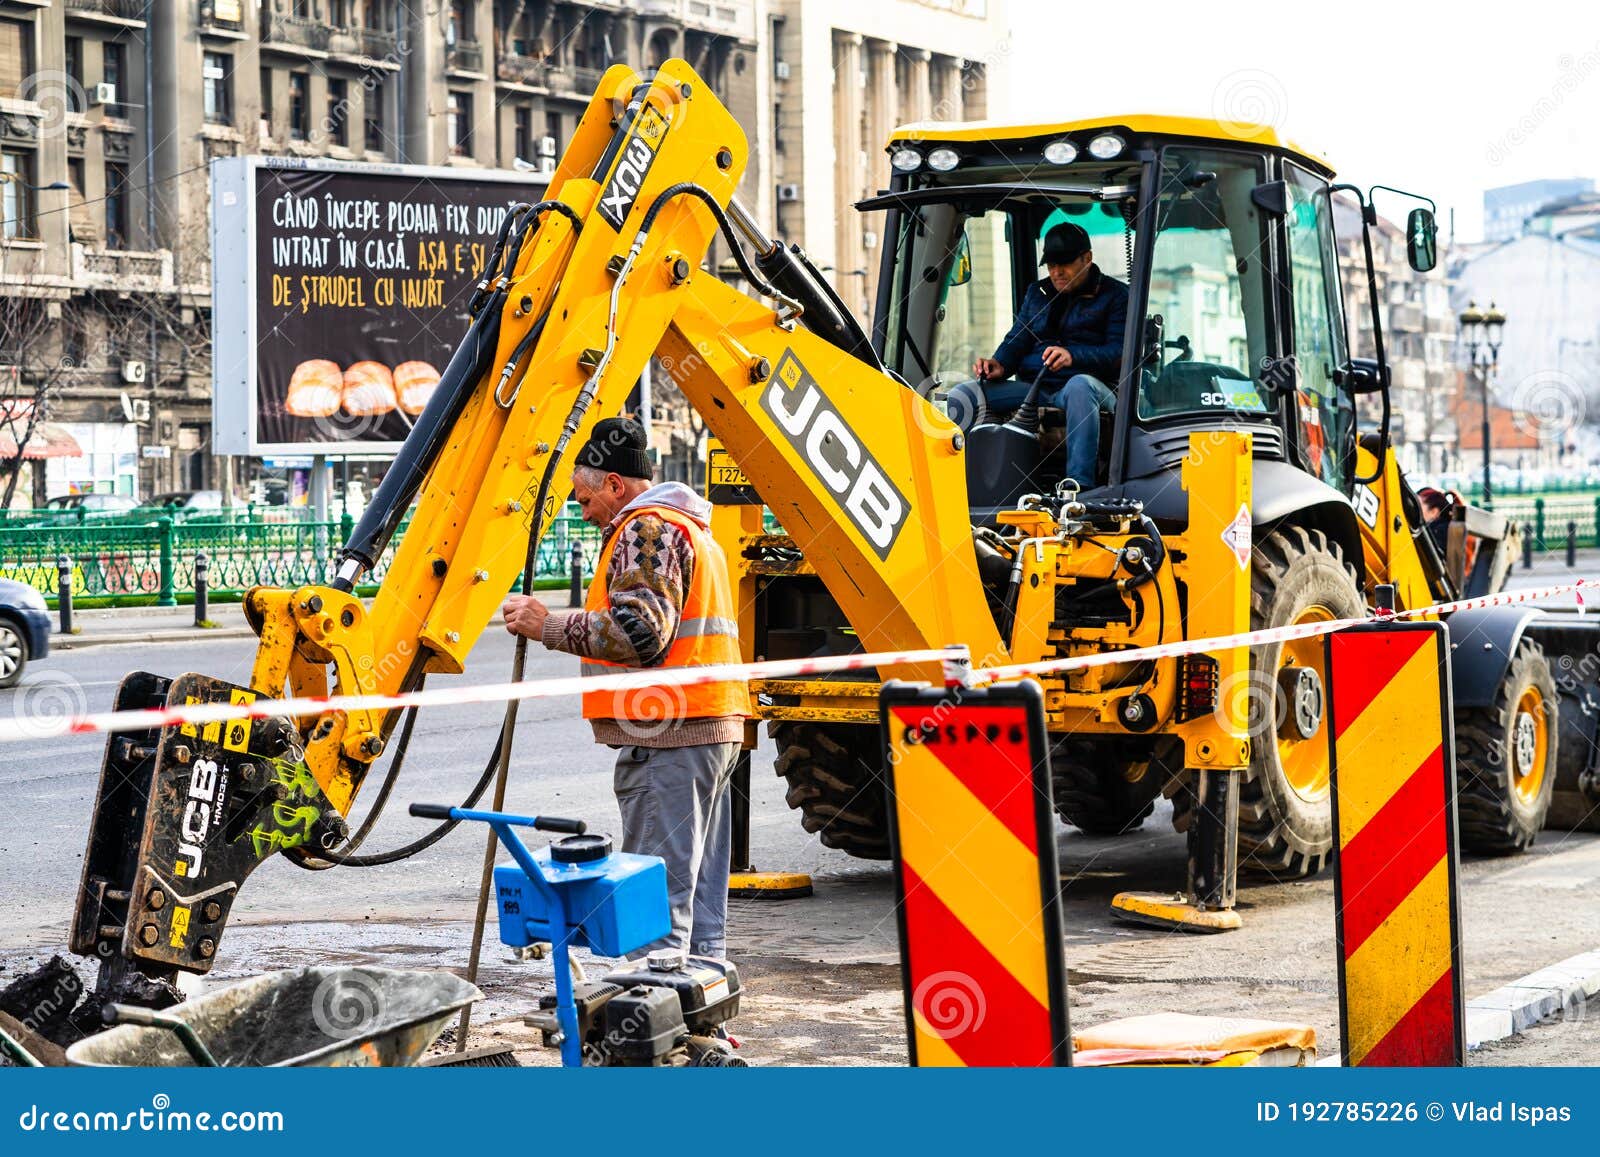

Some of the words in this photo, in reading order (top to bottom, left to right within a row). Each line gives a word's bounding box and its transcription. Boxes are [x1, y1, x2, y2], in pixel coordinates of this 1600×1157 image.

[273, 191, 318, 229] CÂND
[324, 192, 380, 231] ÎNCEPE
[388, 200, 438, 234] PLOAIA
[446, 204, 469, 235] FIX
[273, 235, 331, 268] INTRAT
[337, 232, 357, 268] ÎN
[365, 232, 411, 270] CASĂ.
[455, 243, 463, 272] E
[273, 274, 292, 306] DE
[375, 278, 394, 306] CU
[402, 278, 447, 309] IAURT.
[769, 382, 902, 548] JCB
[178, 759, 218, 879] JCB
